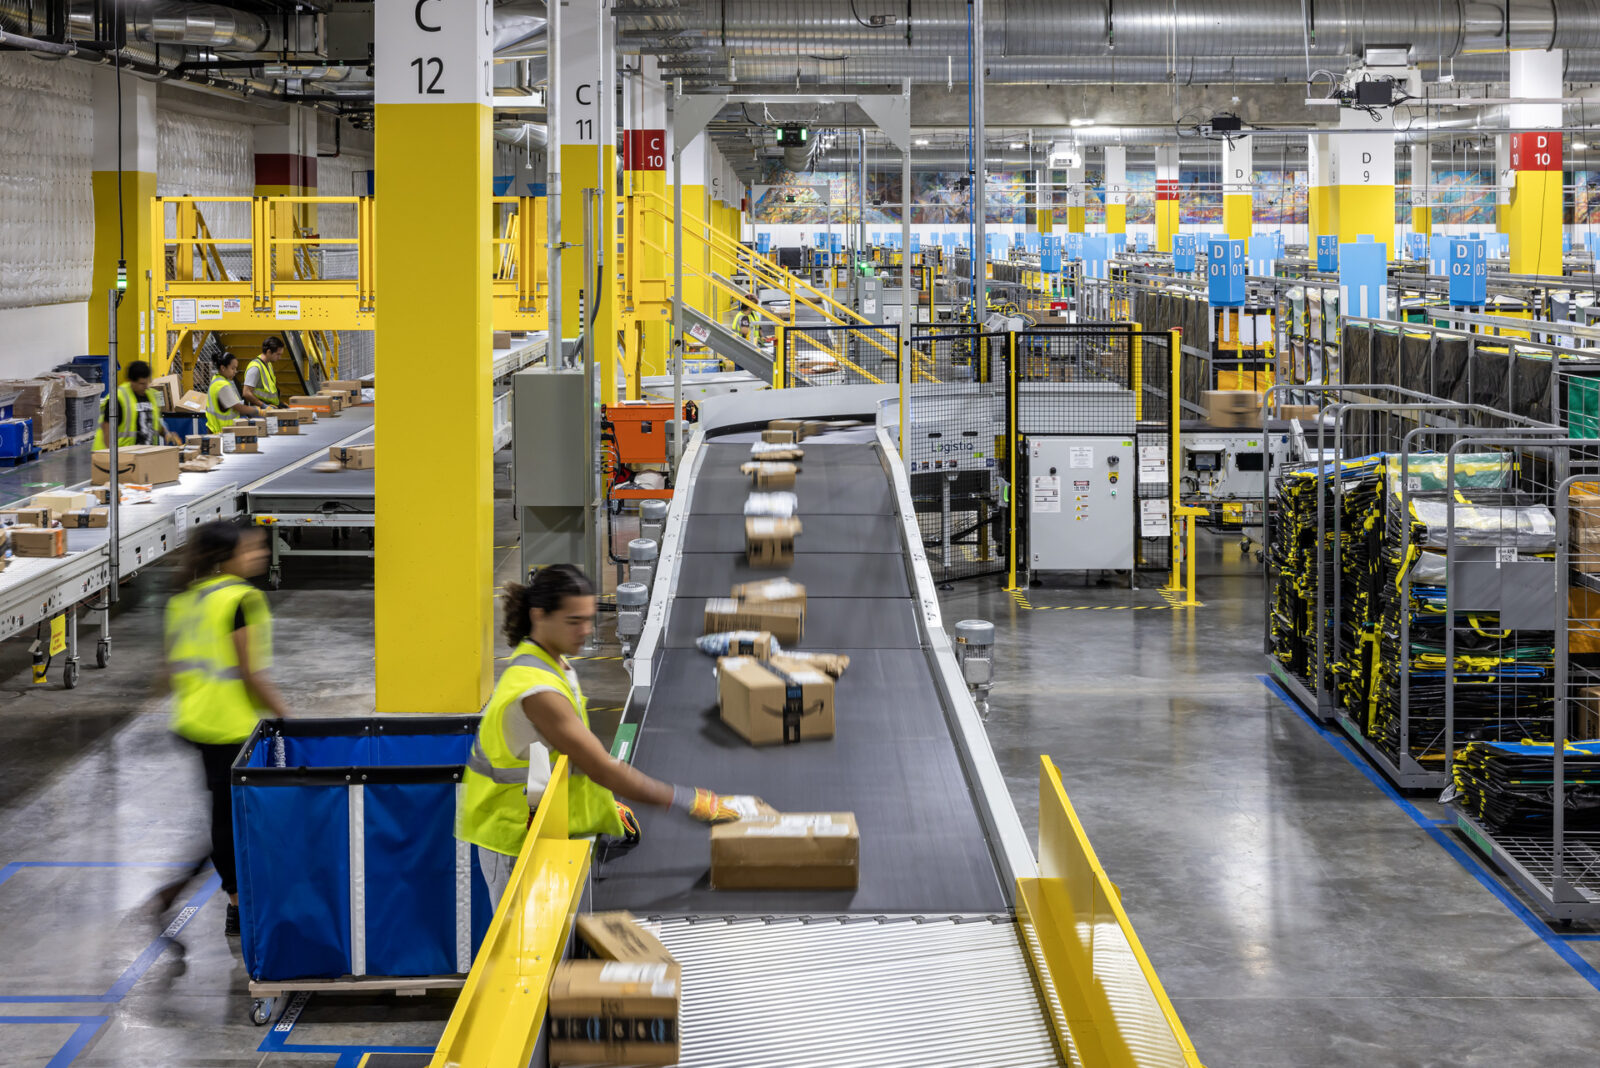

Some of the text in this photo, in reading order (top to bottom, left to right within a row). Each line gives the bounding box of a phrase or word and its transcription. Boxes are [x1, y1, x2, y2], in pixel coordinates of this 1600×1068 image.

[415, 0, 442, 32] C
[411, 57, 445, 94] 12
[576, 84, 592, 105] C
[575, 119, 592, 140] 11
[650, 138, 660, 150] C
[1537, 136, 1547, 148] D
[647, 155, 663, 168] 10
[1362, 152, 1372, 164] D
[1534, 153, 1551, 165] 10
[1235, 169, 1244, 179] D
[1363, 170, 1370, 182] 9
[712, 178, 719, 187] C
[713, 191, 718, 199] 7
[1044, 238, 1049, 247] E
[1055, 238, 1059, 247] E
[1178, 238, 1183, 246] E
[1321, 237, 1326, 246] E
[1176, 248, 1185, 256] 02
[1214, 245, 1224, 259] D
[1234, 245, 1241, 258] D
[1456, 244, 1468, 259] D
[1477, 244, 1484, 259] D
[1211, 264, 1226, 276] 01
[1232, 263, 1243, 276] 01
[1452, 263, 1471, 276] 02
[1475, 263, 1485, 276] 03
